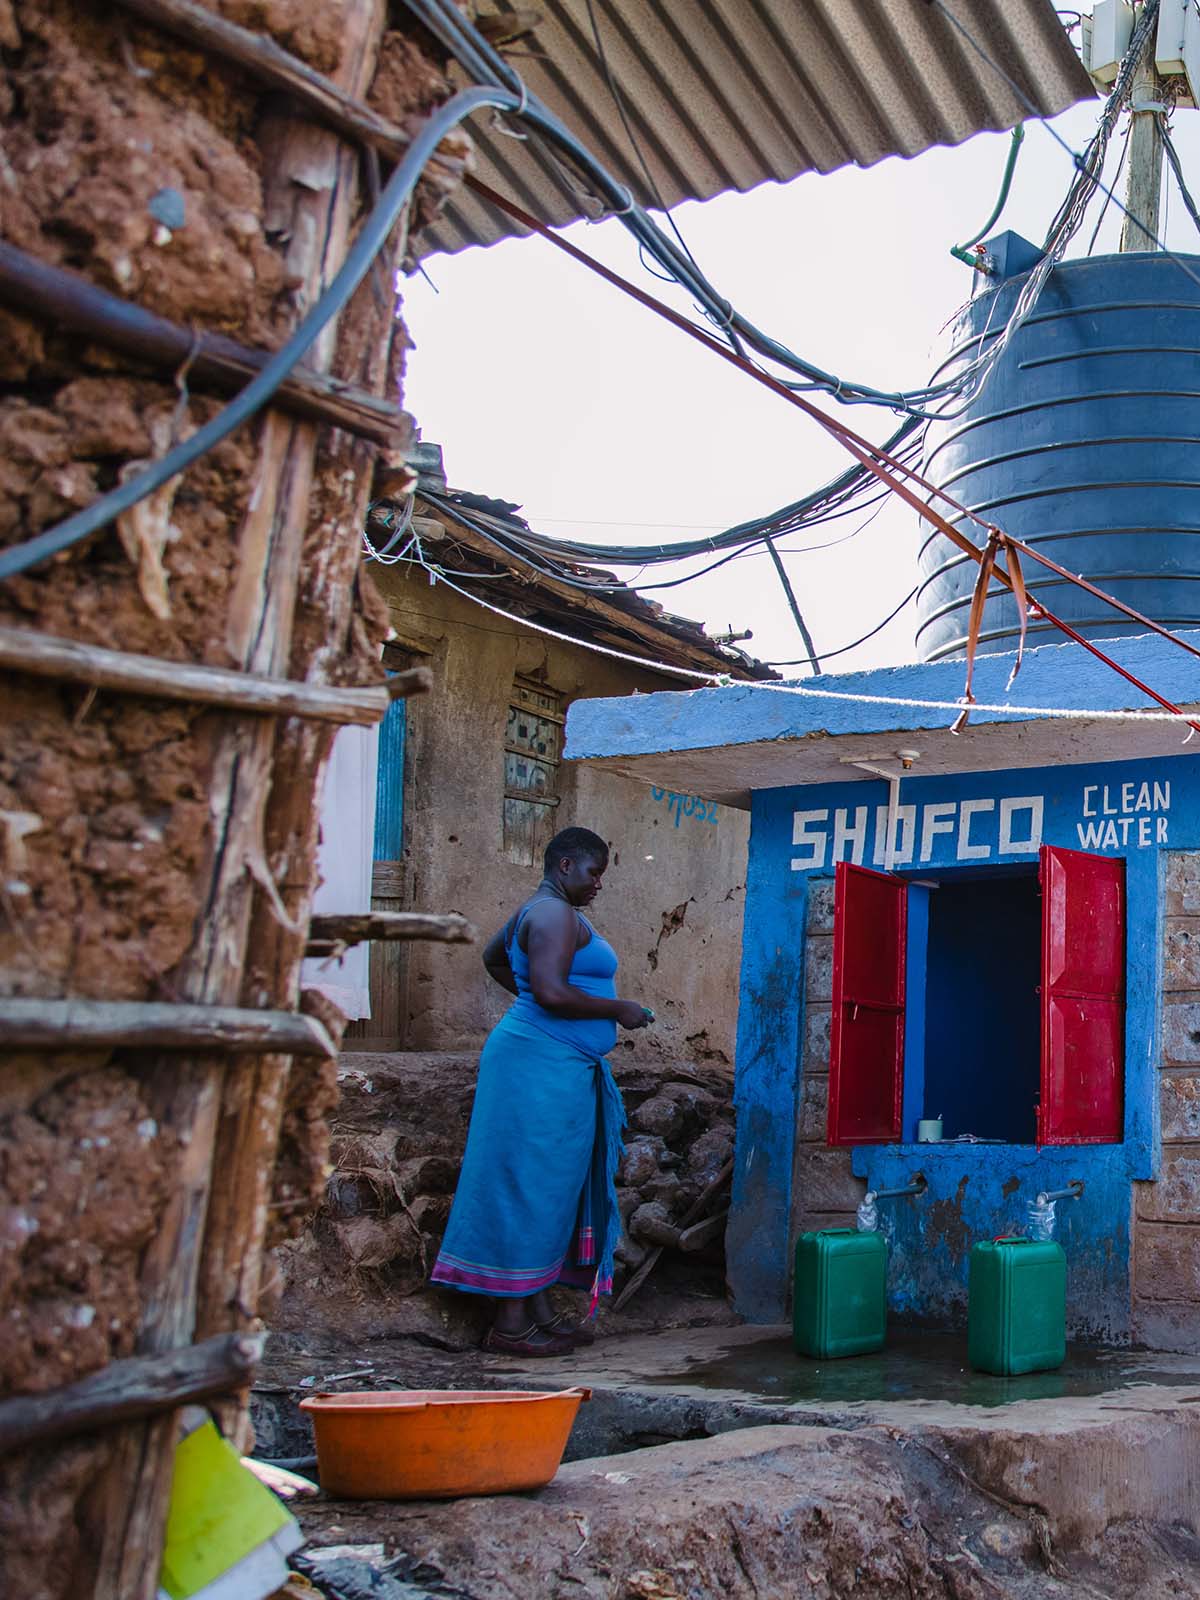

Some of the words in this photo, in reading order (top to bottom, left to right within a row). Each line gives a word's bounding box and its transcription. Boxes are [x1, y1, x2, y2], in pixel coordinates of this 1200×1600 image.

[1083, 781, 1170, 816] CLEAN
[791, 796, 1044, 870] SHOFCO
[1076, 817, 1169, 849] WATER
